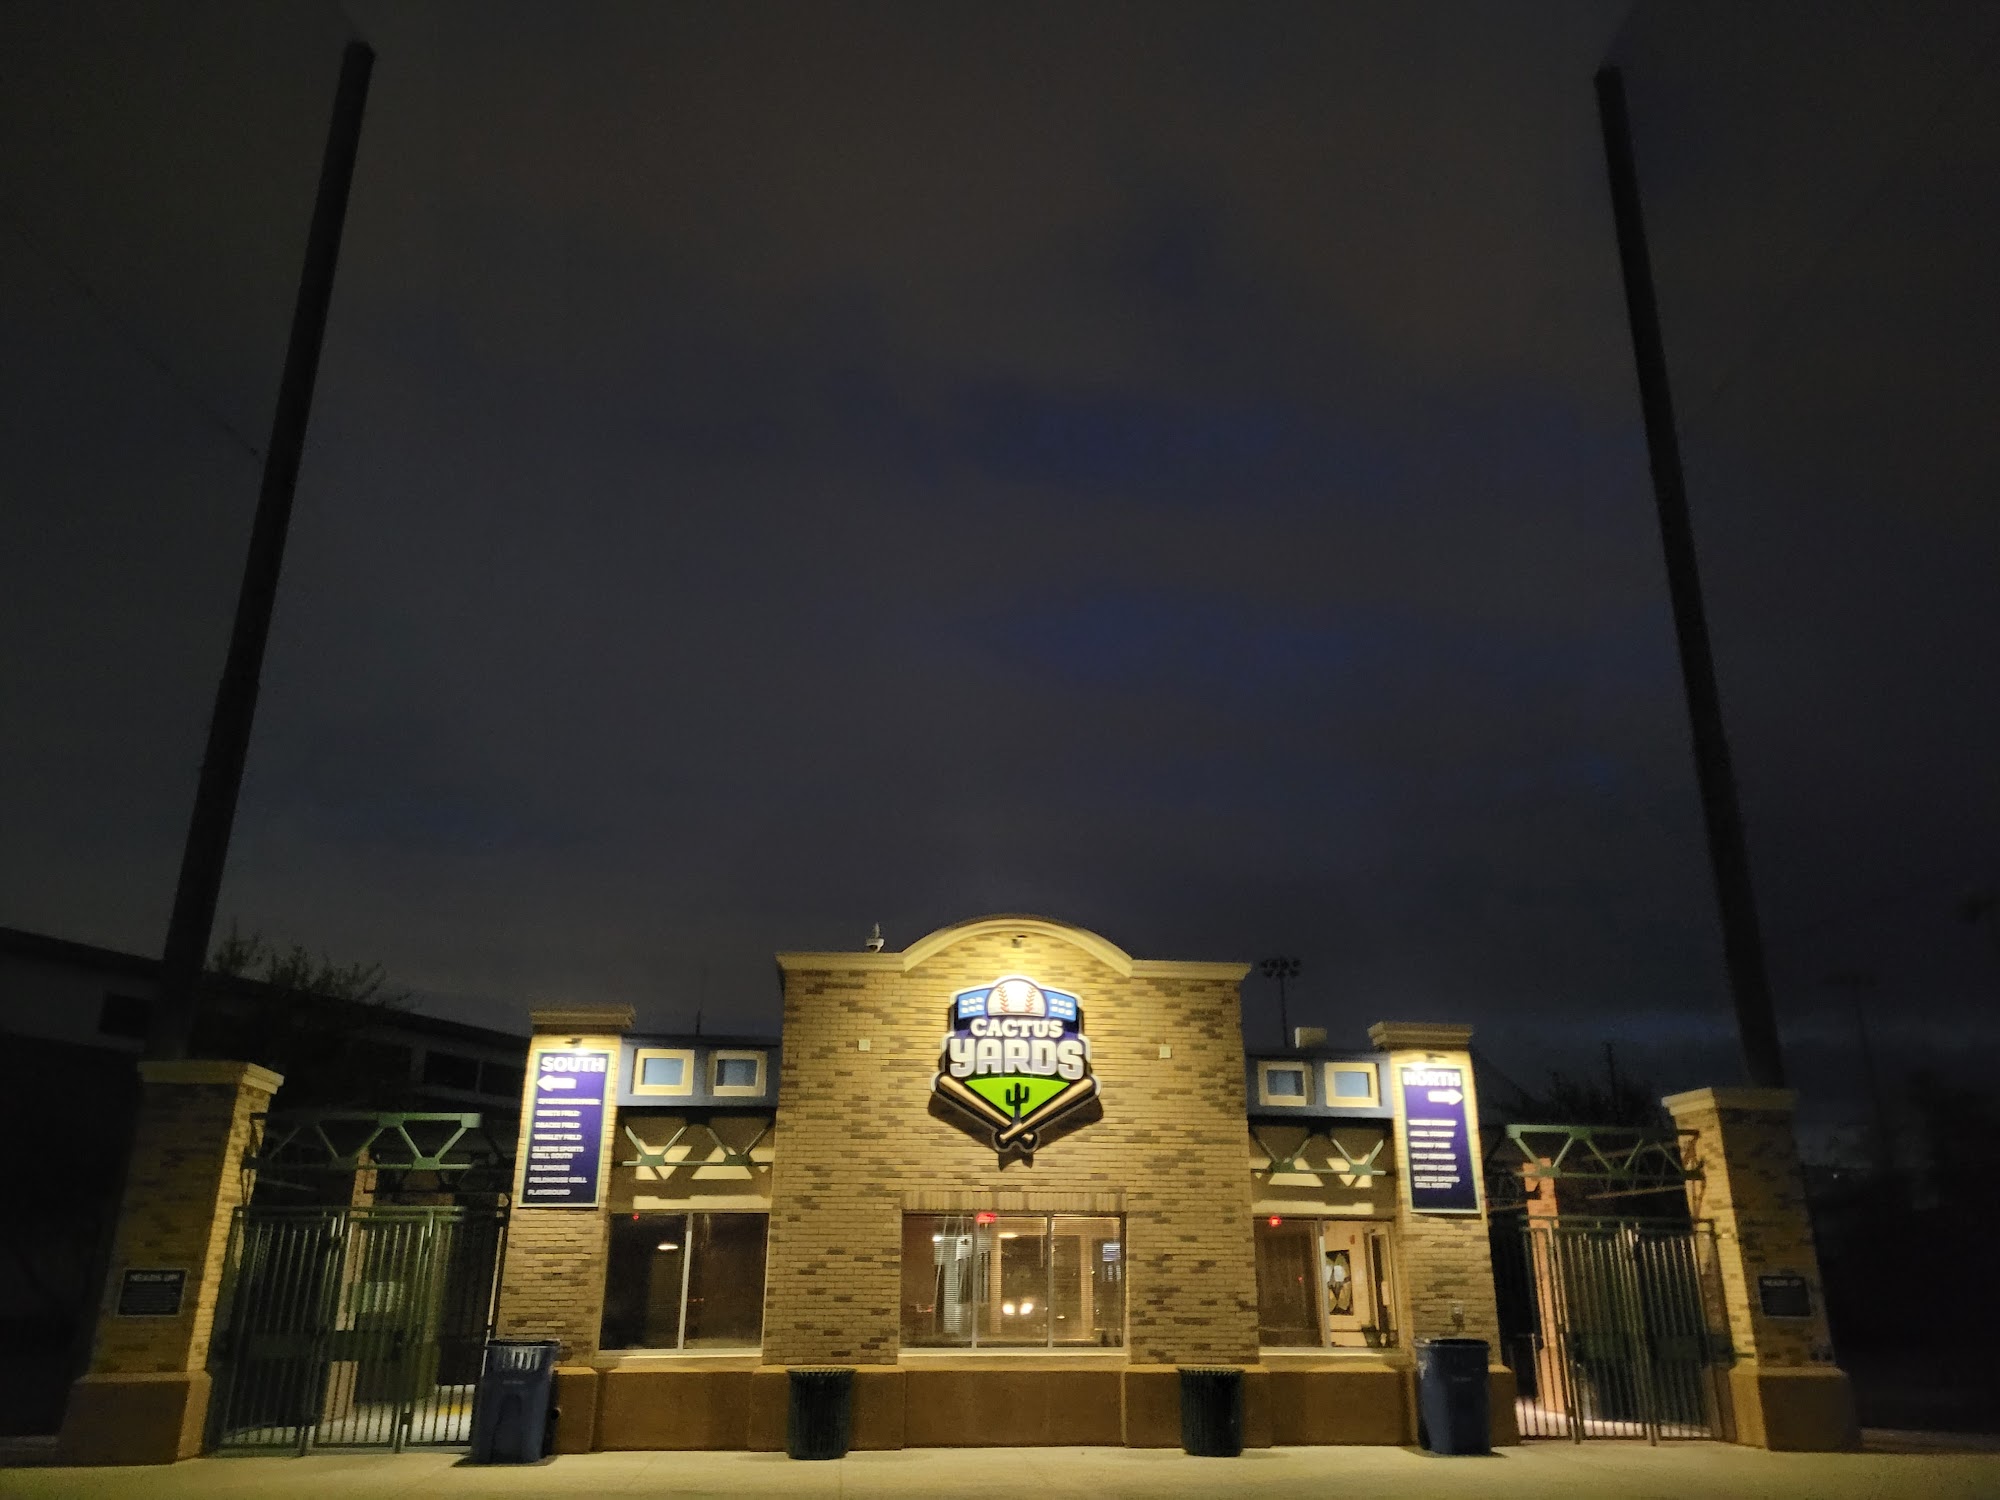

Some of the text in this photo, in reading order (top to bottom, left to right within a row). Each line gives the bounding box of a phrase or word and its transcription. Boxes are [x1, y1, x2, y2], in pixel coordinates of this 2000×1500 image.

[970, 1018, 1064, 1038] CACTUS
[541, 1056, 606, 1073] SOUTH
[949, 1038, 1084, 1080] YARDS
[1403, 1071, 1461, 1087] NORTH
